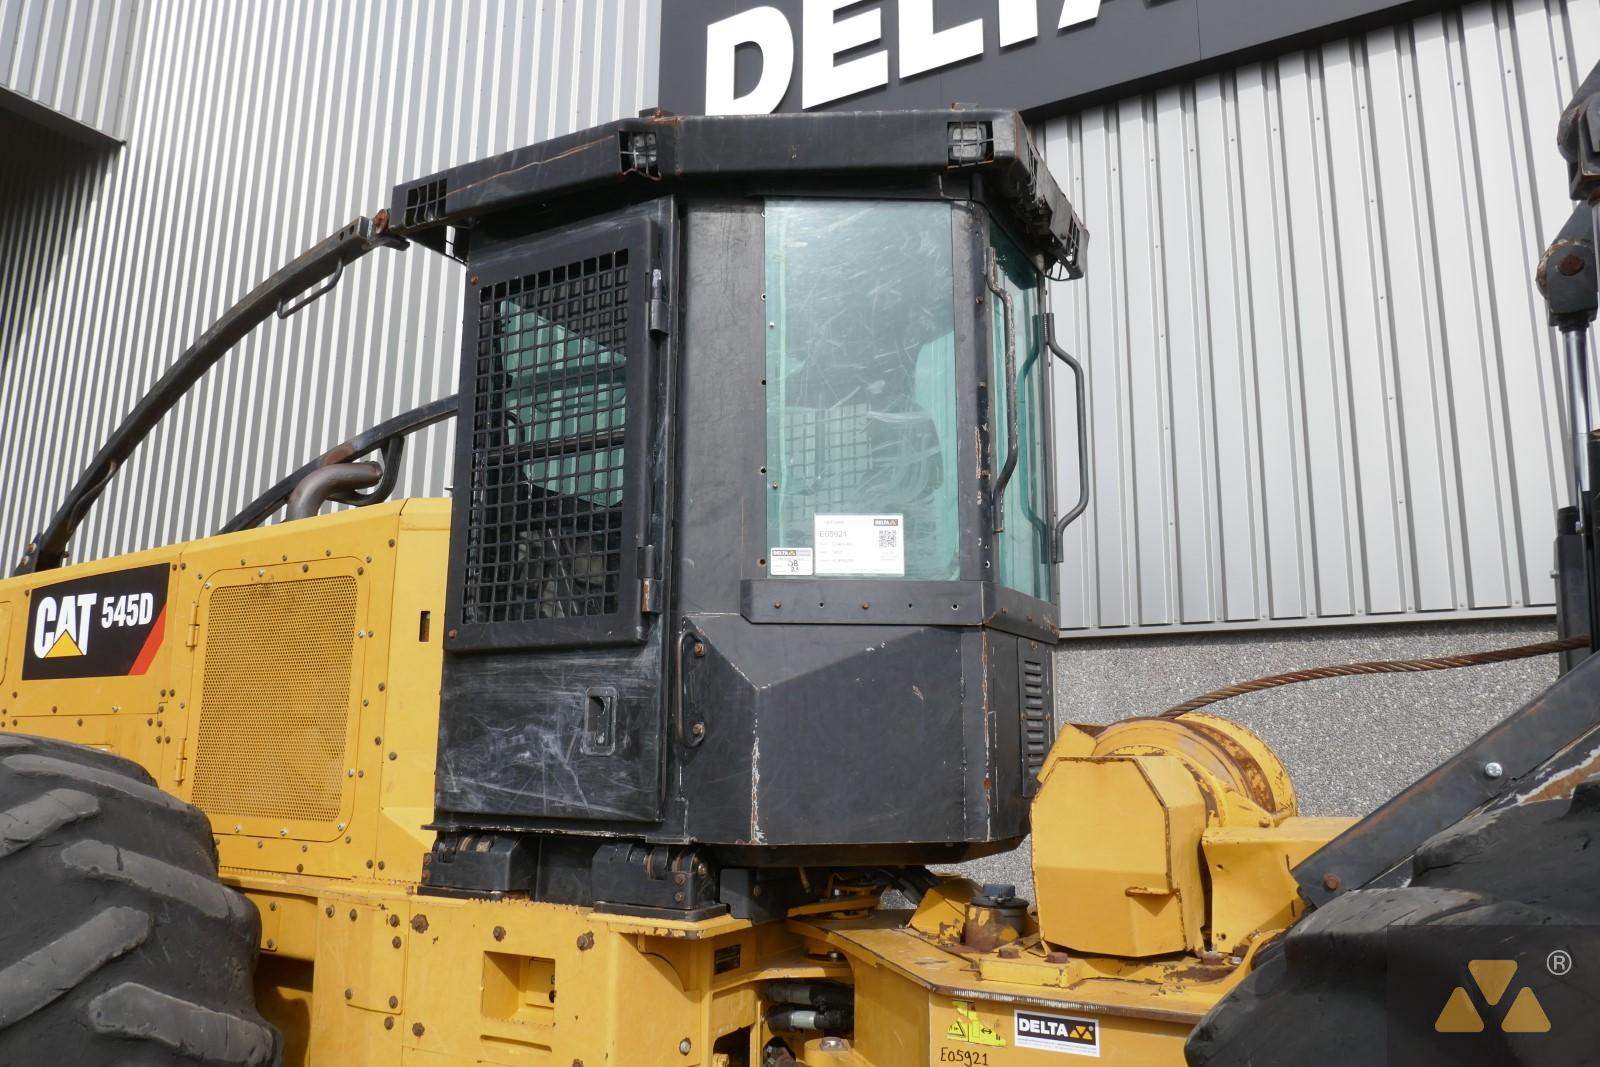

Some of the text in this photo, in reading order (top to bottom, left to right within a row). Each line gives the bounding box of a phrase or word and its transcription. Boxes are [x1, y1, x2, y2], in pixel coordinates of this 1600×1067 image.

[704, 0, 1101, 116] DEL
[33, 592, 154, 659] CAT 545D
[1018, 1018, 1068, 1037] DELTA
